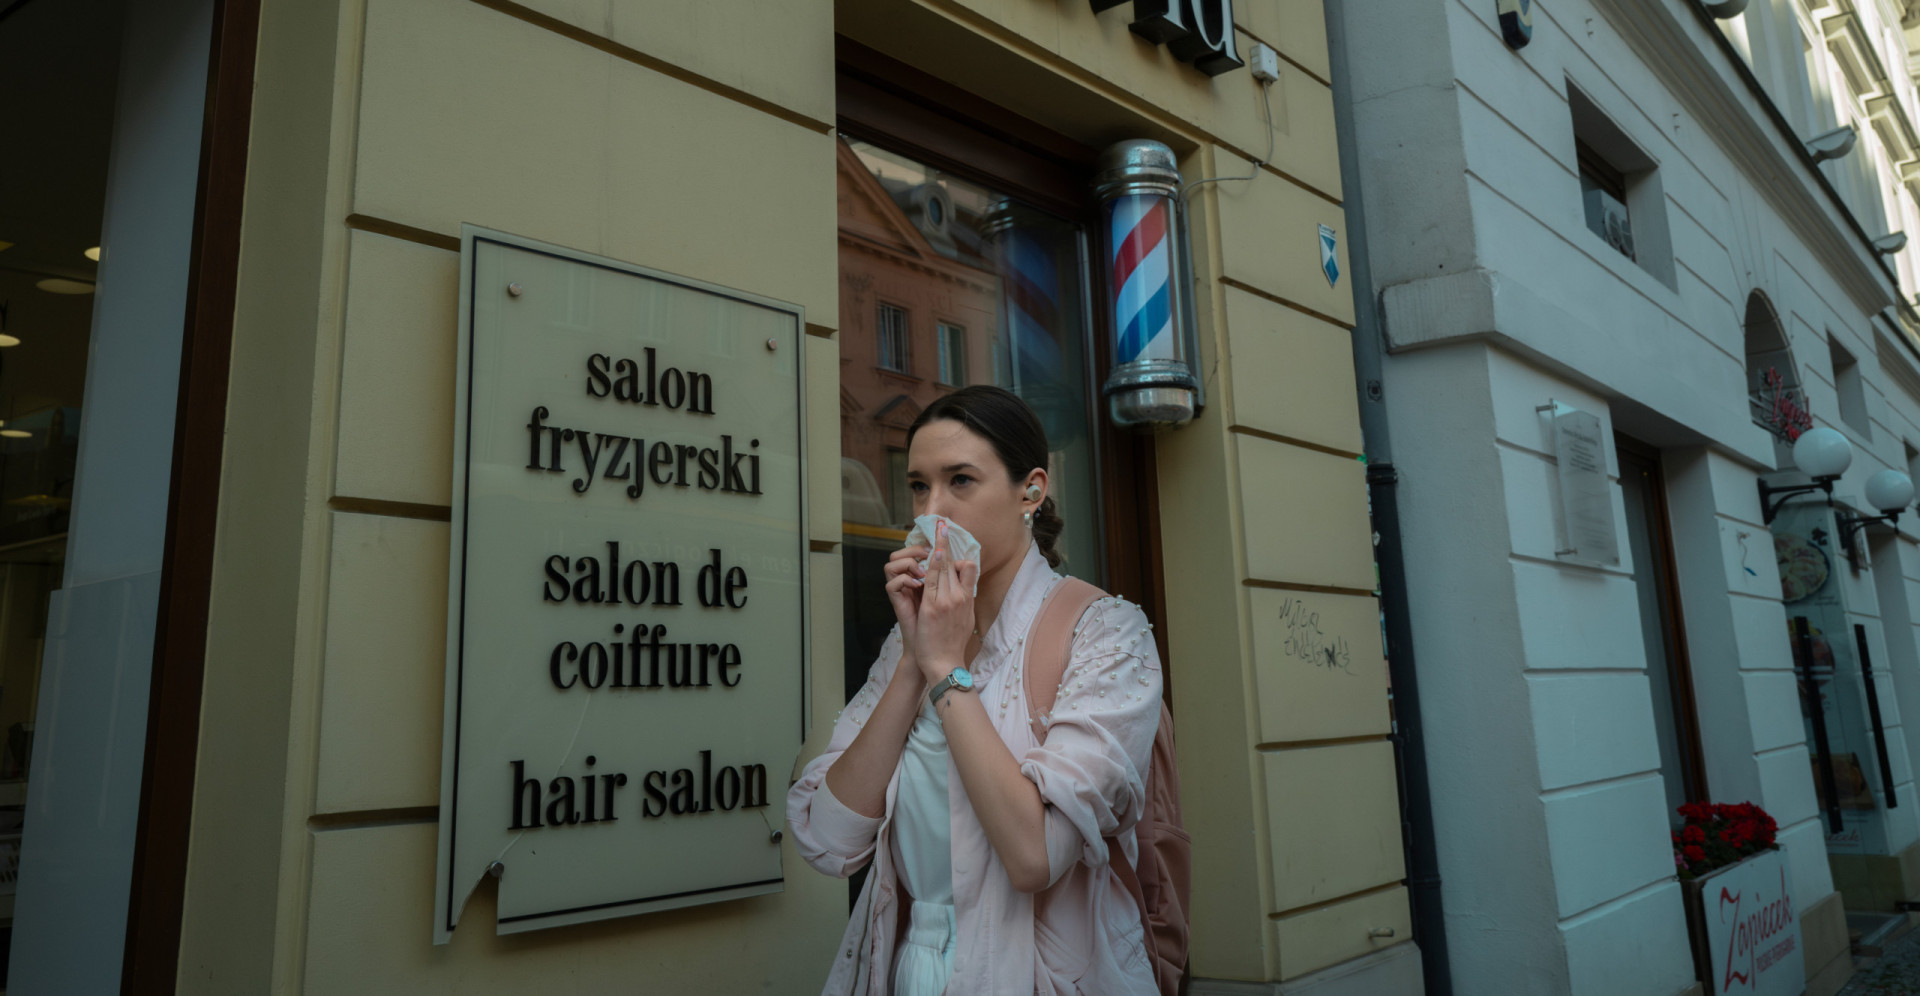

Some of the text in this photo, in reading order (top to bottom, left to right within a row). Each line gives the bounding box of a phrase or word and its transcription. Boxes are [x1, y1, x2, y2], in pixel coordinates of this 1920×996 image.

[586, 346, 716, 416] salon
[526, 405, 763, 500] fryzjerski
[543, 541, 683, 608] salon
[696, 548, 749, 610] de
[549, 623, 742, 691] coiffure
[506, 749, 771, 833] hair salon
[1719, 864, 1793, 993] Zapiecek
